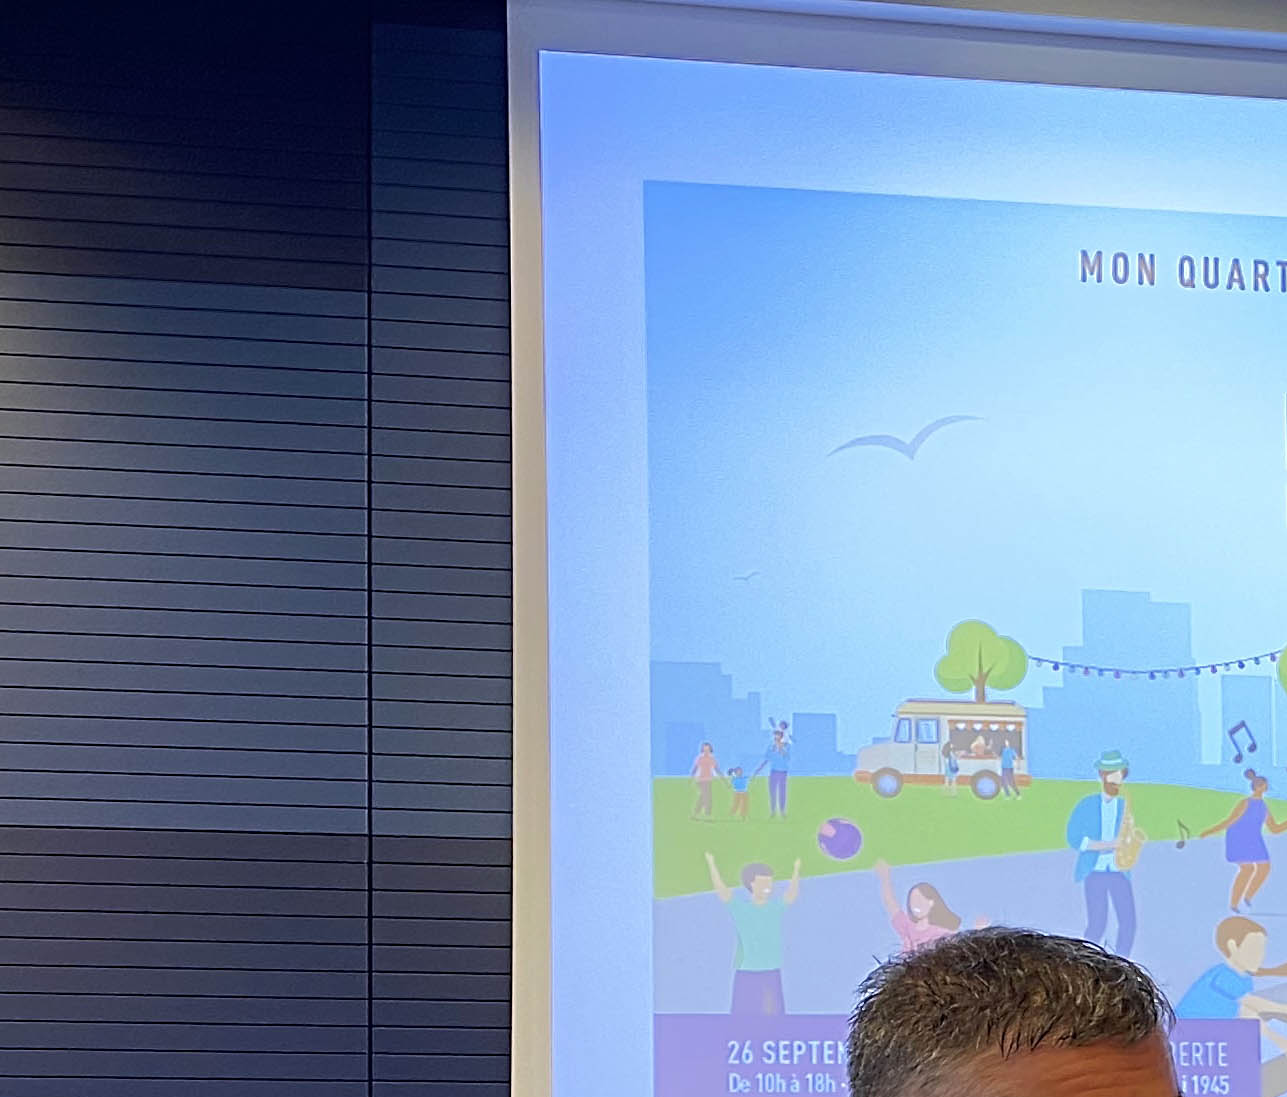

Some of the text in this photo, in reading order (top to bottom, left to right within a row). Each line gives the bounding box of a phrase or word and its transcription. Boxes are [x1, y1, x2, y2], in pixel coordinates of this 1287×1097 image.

[1079, 249, 1156, 287] MON
[728, 1040, 753, 1065] 26
[728, 1073, 836, 1093] De 10h à 18h
[1191, 1075, 1230, 1095] 1945
